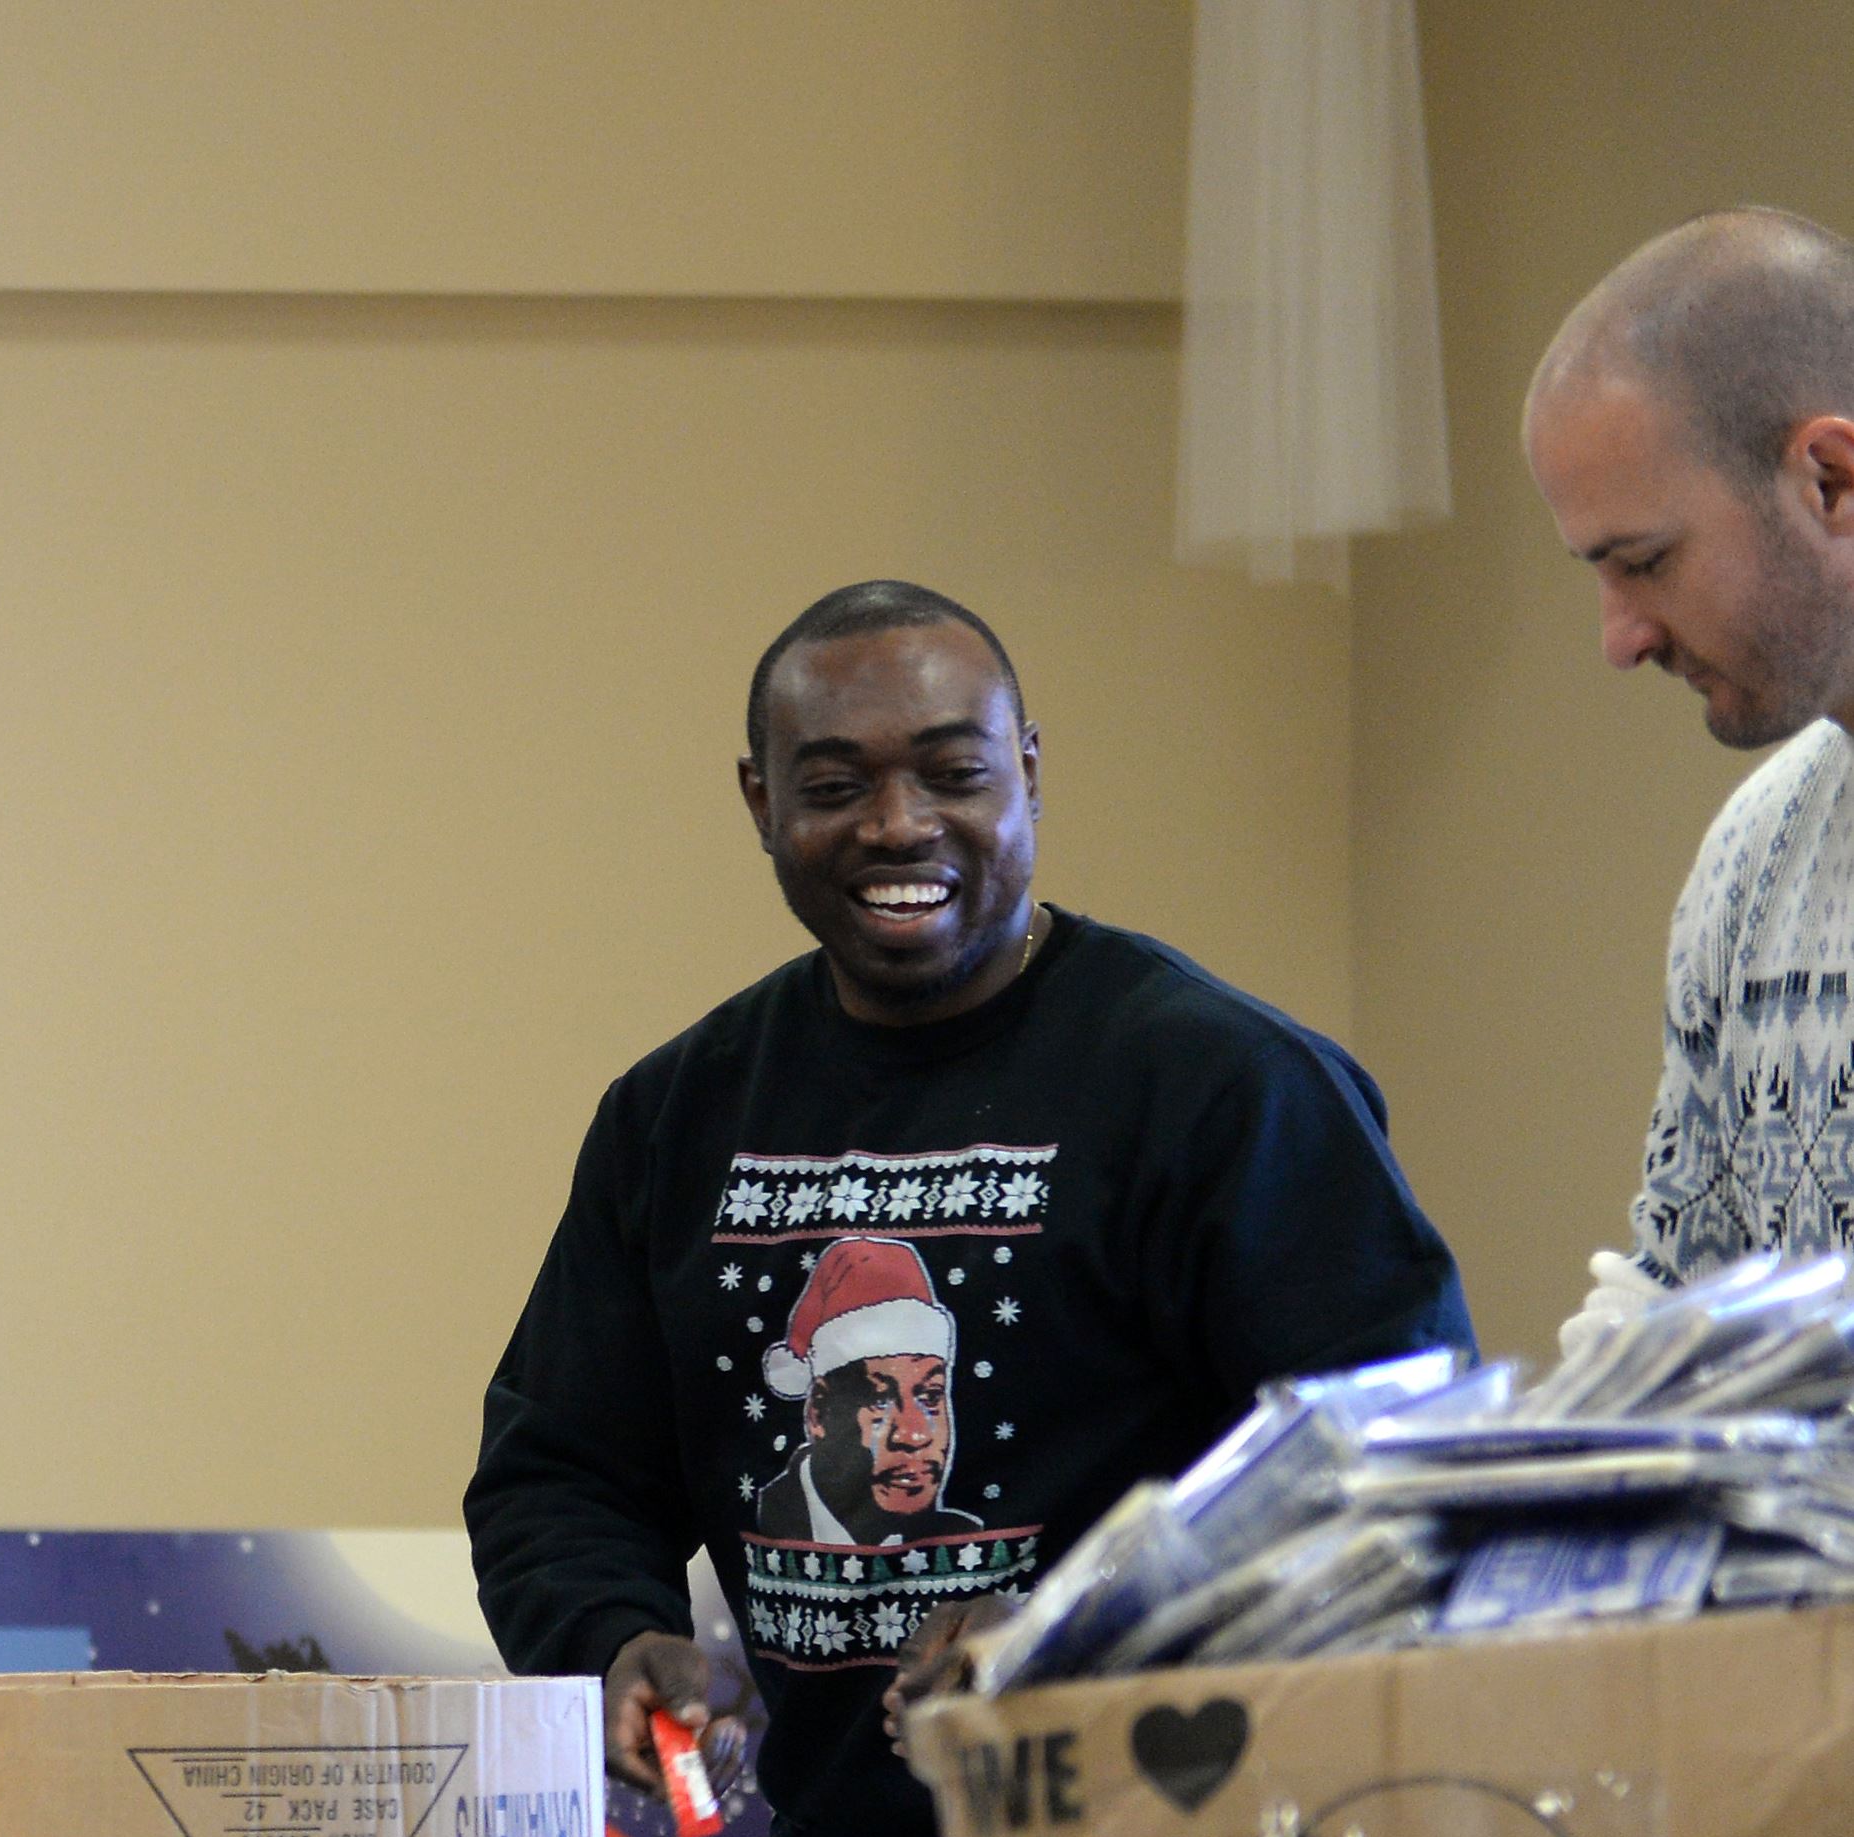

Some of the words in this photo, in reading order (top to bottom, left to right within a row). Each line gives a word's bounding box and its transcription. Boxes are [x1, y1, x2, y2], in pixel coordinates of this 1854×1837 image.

[183, 1764, 242, 1788] CHINA
[249, 1763, 314, 1788] ORIGIN
[321, 1762, 345, 1787] OF
[352, 1761, 437, 1786] COUNTRY
[956, 1730, 1081, 1837] WE
[243, 1799, 266, 1822] 42
[288, 1799, 338, 1821] PACK
[353, 1797, 398, 1821] CASE
